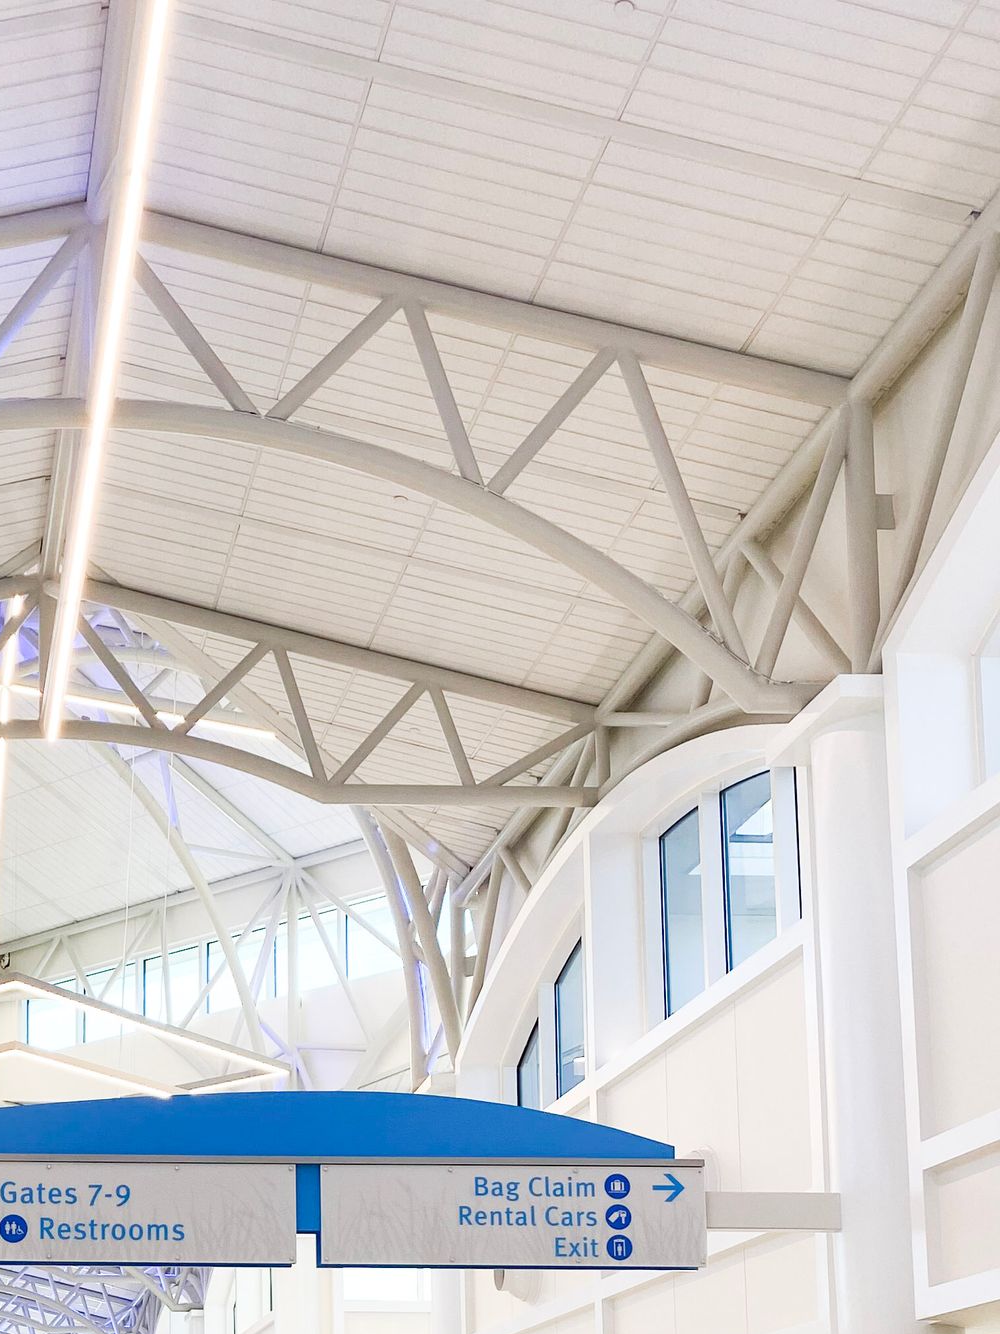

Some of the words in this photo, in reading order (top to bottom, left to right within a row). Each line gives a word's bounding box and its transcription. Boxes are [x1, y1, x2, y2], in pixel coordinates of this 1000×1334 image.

[0, 1181, 78, 1205] Gates
[89, 1184, 132, 1207] 7-9
[474, 1176, 520, 1202] Bag
[528, 1177, 596, 1198] Claim
[458, 1205, 537, 1227] Rental
[544, 1207, 598, 1227] Cars
[39, 1217, 185, 1242] Restrooms
[554, 1236, 600, 1258] Exit
